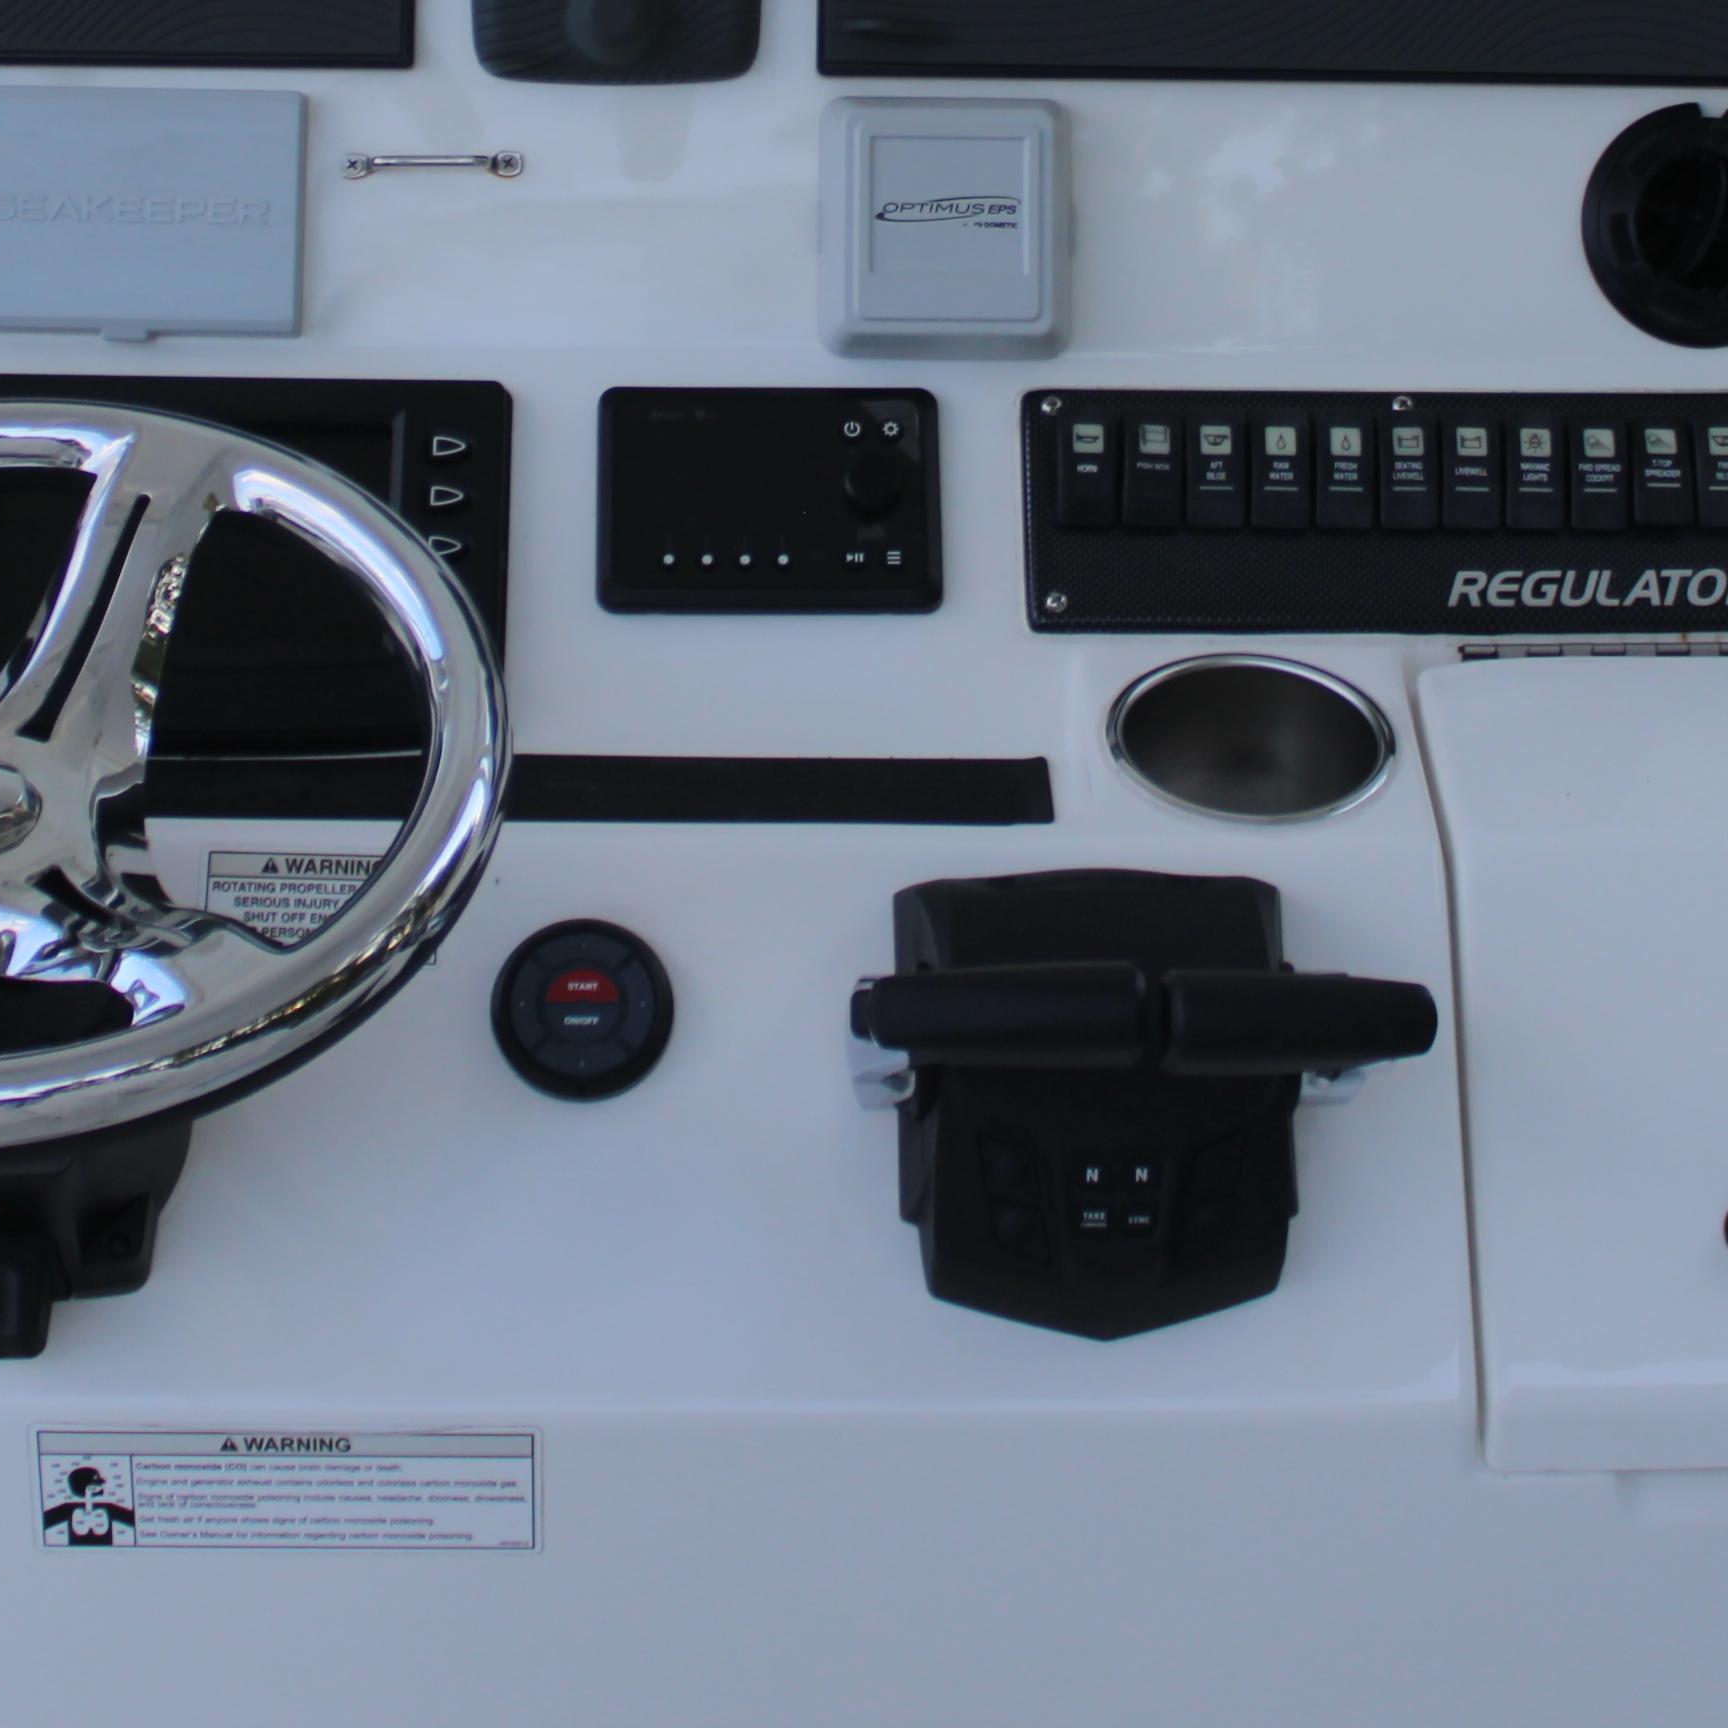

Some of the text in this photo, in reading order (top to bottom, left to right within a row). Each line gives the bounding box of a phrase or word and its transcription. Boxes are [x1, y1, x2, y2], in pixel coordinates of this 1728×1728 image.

[882, 202, 1017, 215] OPTIMUS EPS
[1076, 464, 1098, 474] HORN
[1334, 461, 1358, 471] FRESH
[1269, 472, 1294, 481] WATER
[1333, 472, 1358, 481] WATER
[1455, 467, 1488, 477] LIVEWELL
[1522, 472, 1549, 482] LIGHTS
[212, 880, 356, 895] ROTATING PROPELLER
[233, 896, 339, 910] SERIOUS INJURY
[243, 911, 327, 925] SHUT OFF EN
[568, 982, 598, 990] START
[1086, 1167, 1099, 1183] N
[1135, 1167, 1148, 1183] N
[1083, 1211, 1105, 1220] TAKE
[1128, 1216, 1150, 1225] SYNC
[243, 1436, 352, 1453] WARNING
[136, 1463, 171, 1471] Carbon
[174, 1463, 222, 1471] monoxide
